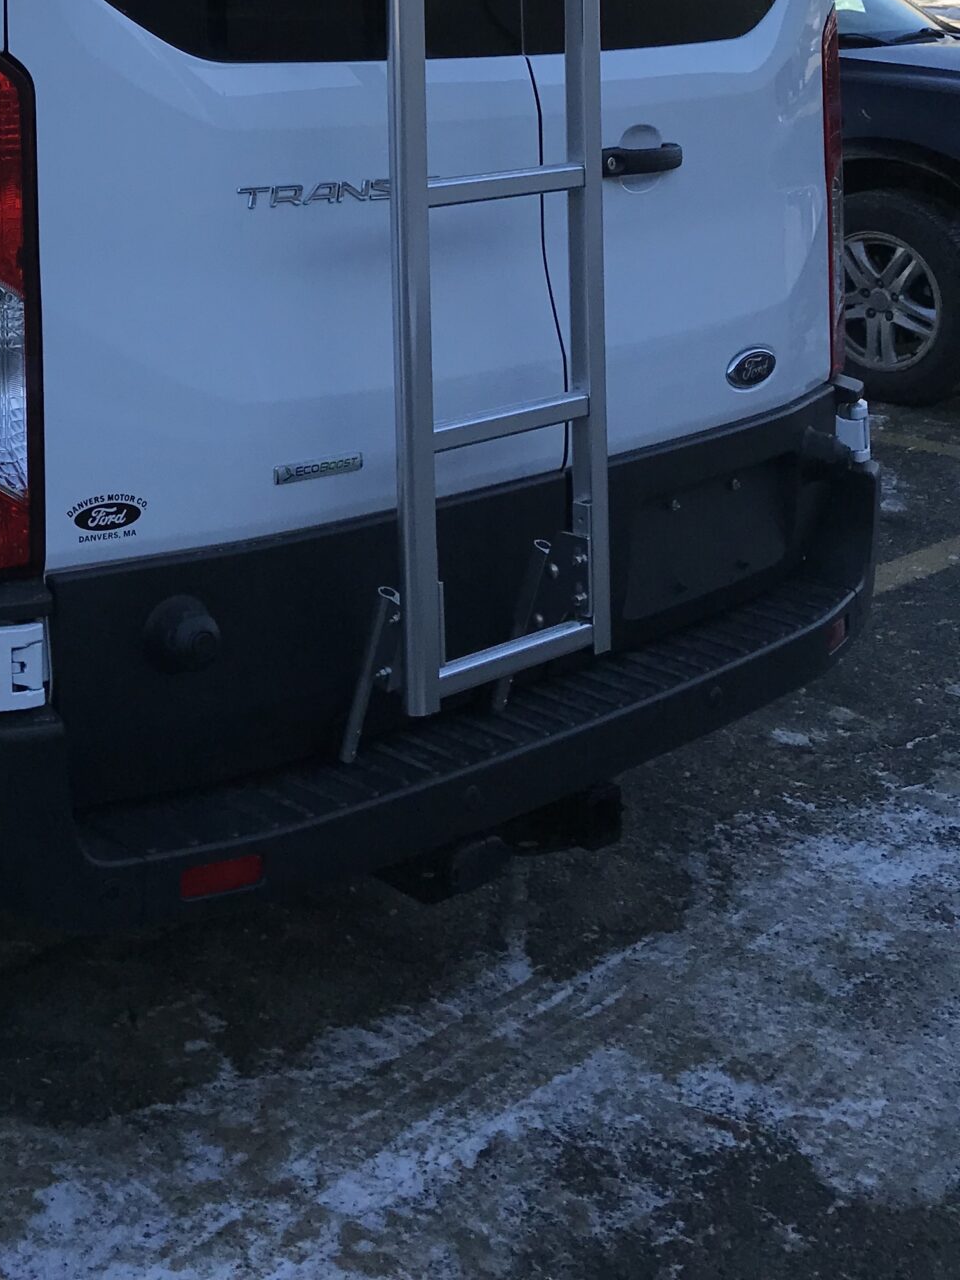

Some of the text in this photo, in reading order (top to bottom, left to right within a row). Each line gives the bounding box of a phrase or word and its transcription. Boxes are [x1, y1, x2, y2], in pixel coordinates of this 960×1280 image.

[237, 178, 390, 210] TRANS
[742, 356, 769, 380] Ford
[295, 457, 358, 477] ECOBOOST
[66, 495, 105, 518] DANVERS
[106, 493, 135, 503] MOTOR
[87, 506, 127, 527] Ford
[78, 529, 137, 543] DANVERS, MA
